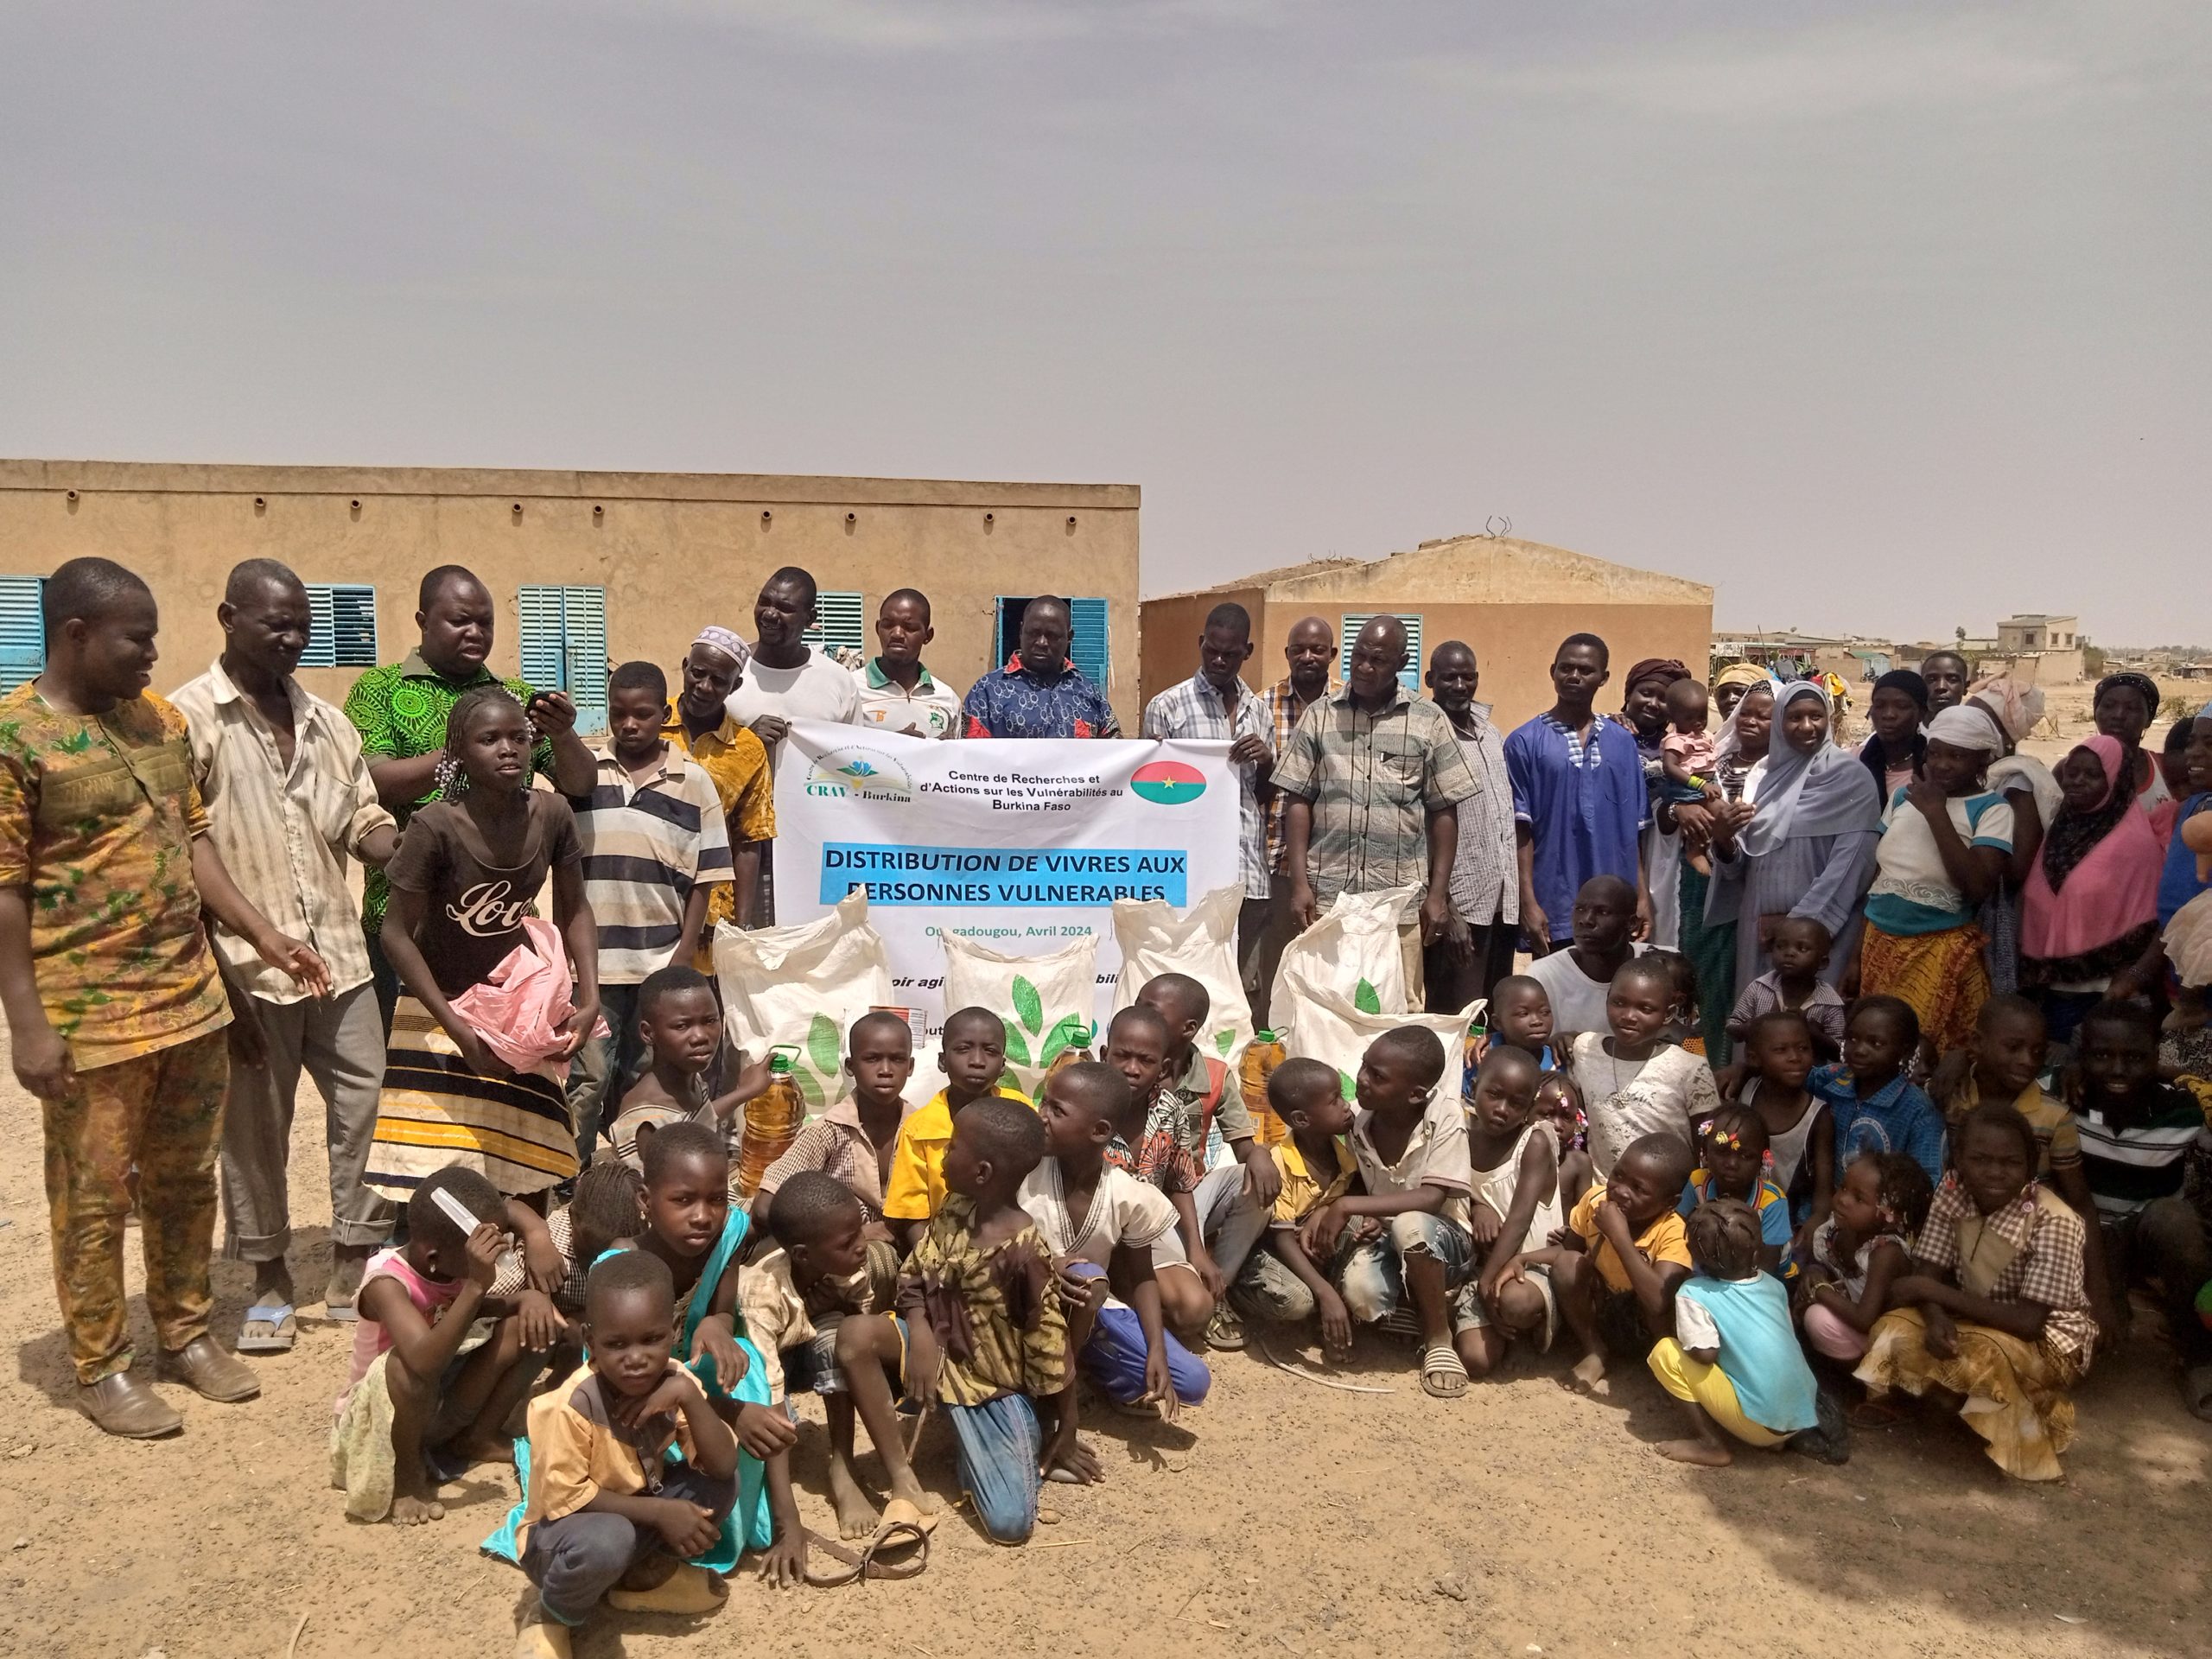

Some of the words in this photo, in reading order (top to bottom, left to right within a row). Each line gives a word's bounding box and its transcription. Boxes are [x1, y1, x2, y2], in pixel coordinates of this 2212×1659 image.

[949, 771, 989, 783] Centre
[1012, 774, 1085, 785] Recherches
[1089, 775, 1100, 784] et
[806, 785, 847, 798] CRAV
[862, 791, 911, 803] Burkina
[920, 783, 980, 795] d'Actions
[1007, 787, 1023, 797] les
[1027, 788, 1107, 798] Vulnérabilités
[993, 799, 1040, 810] Burkina
[1044, 802, 1071, 810] Faso
[825, 849, 1001, 872] DISTRIBUTION
[1007, 855, 1038, 872] DE
[1046, 855, 1129, 873] VIVRES
[1137, 856, 1185, 874] AUX
[998, 884, 1165, 902] VULNERABLES
[446, 880, 533, 938] Lov
[925, 926, 1021, 938] Ougadougou,
[1026, 926, 1057, 937] Avril
[1060, 926, 1092, 937] 2024
[918, 976, 944, 989] agi
